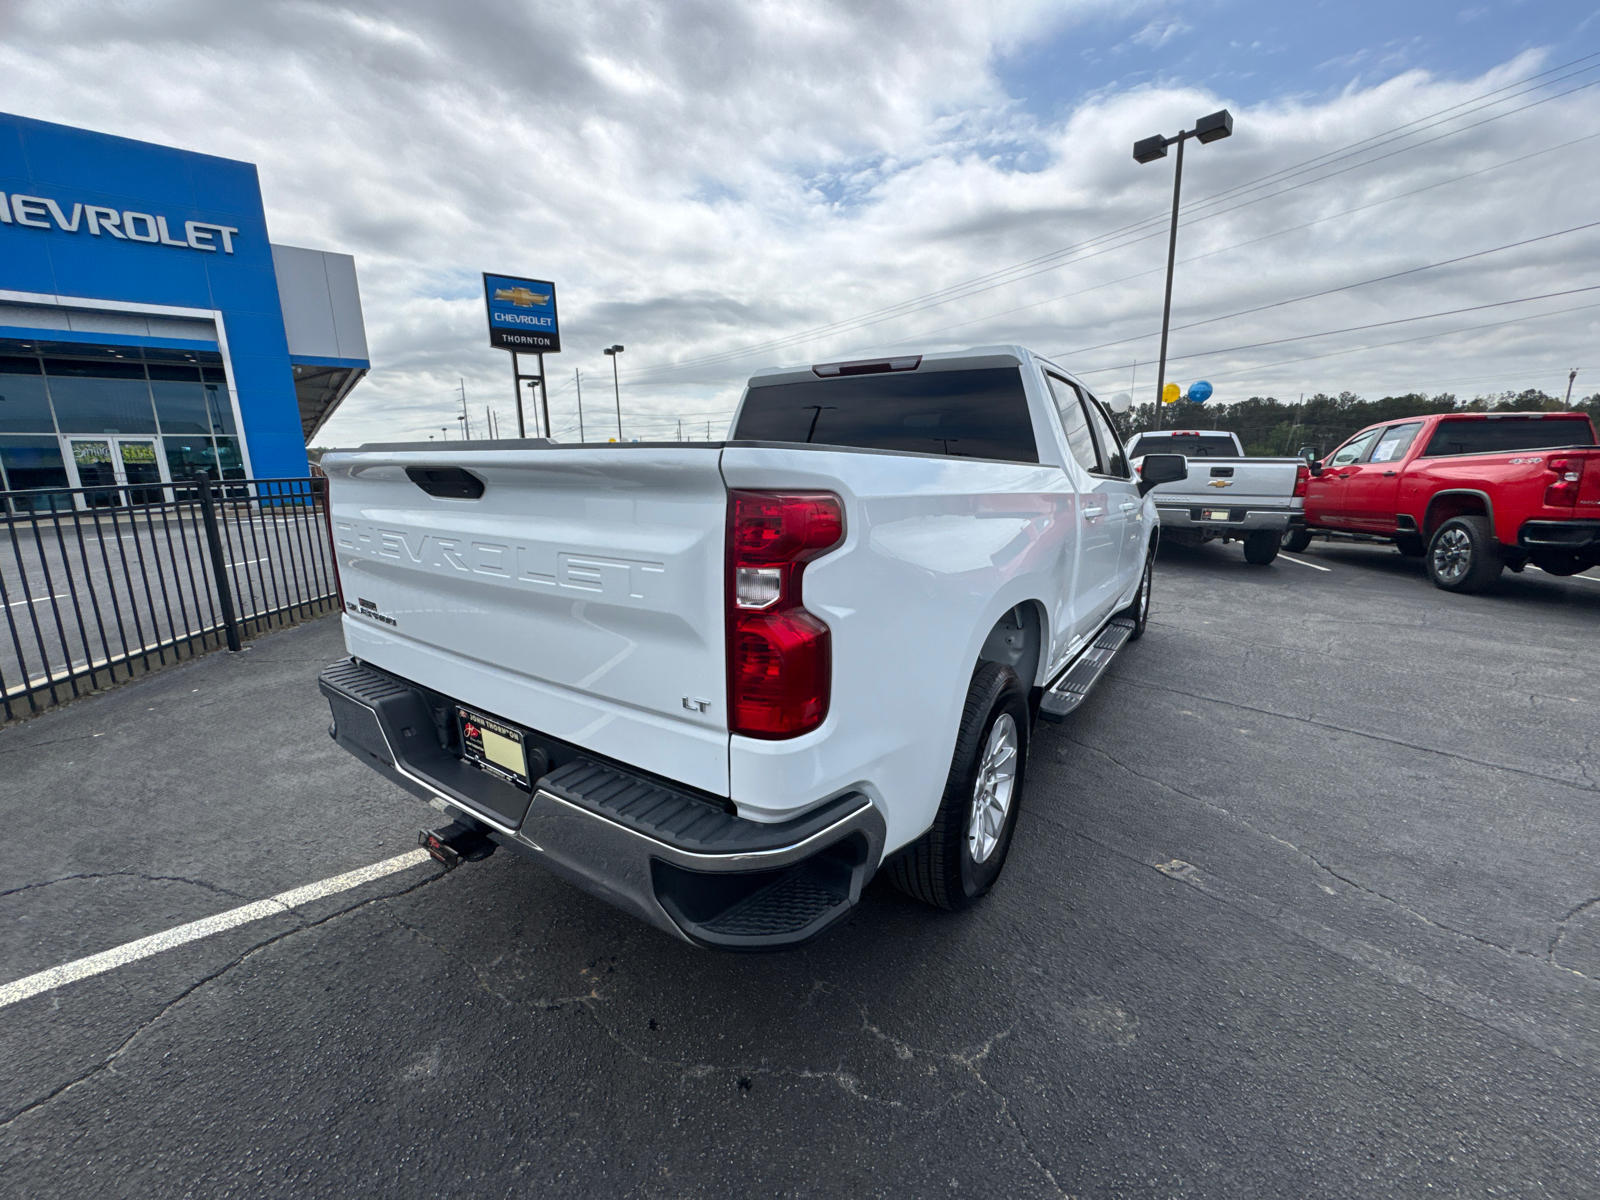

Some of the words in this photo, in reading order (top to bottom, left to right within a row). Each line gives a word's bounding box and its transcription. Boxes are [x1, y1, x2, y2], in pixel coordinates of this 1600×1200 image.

[494, 312, 552, 326] CHEVROLET
[502, 334, 551, 346] THORNTON
[336, 522, 665, 599] CHEVROLET
[682, 696, 711, 713] LT
[469, 714, 486, 726] JOHN
[486, 720, 519, 741] THORNTON
